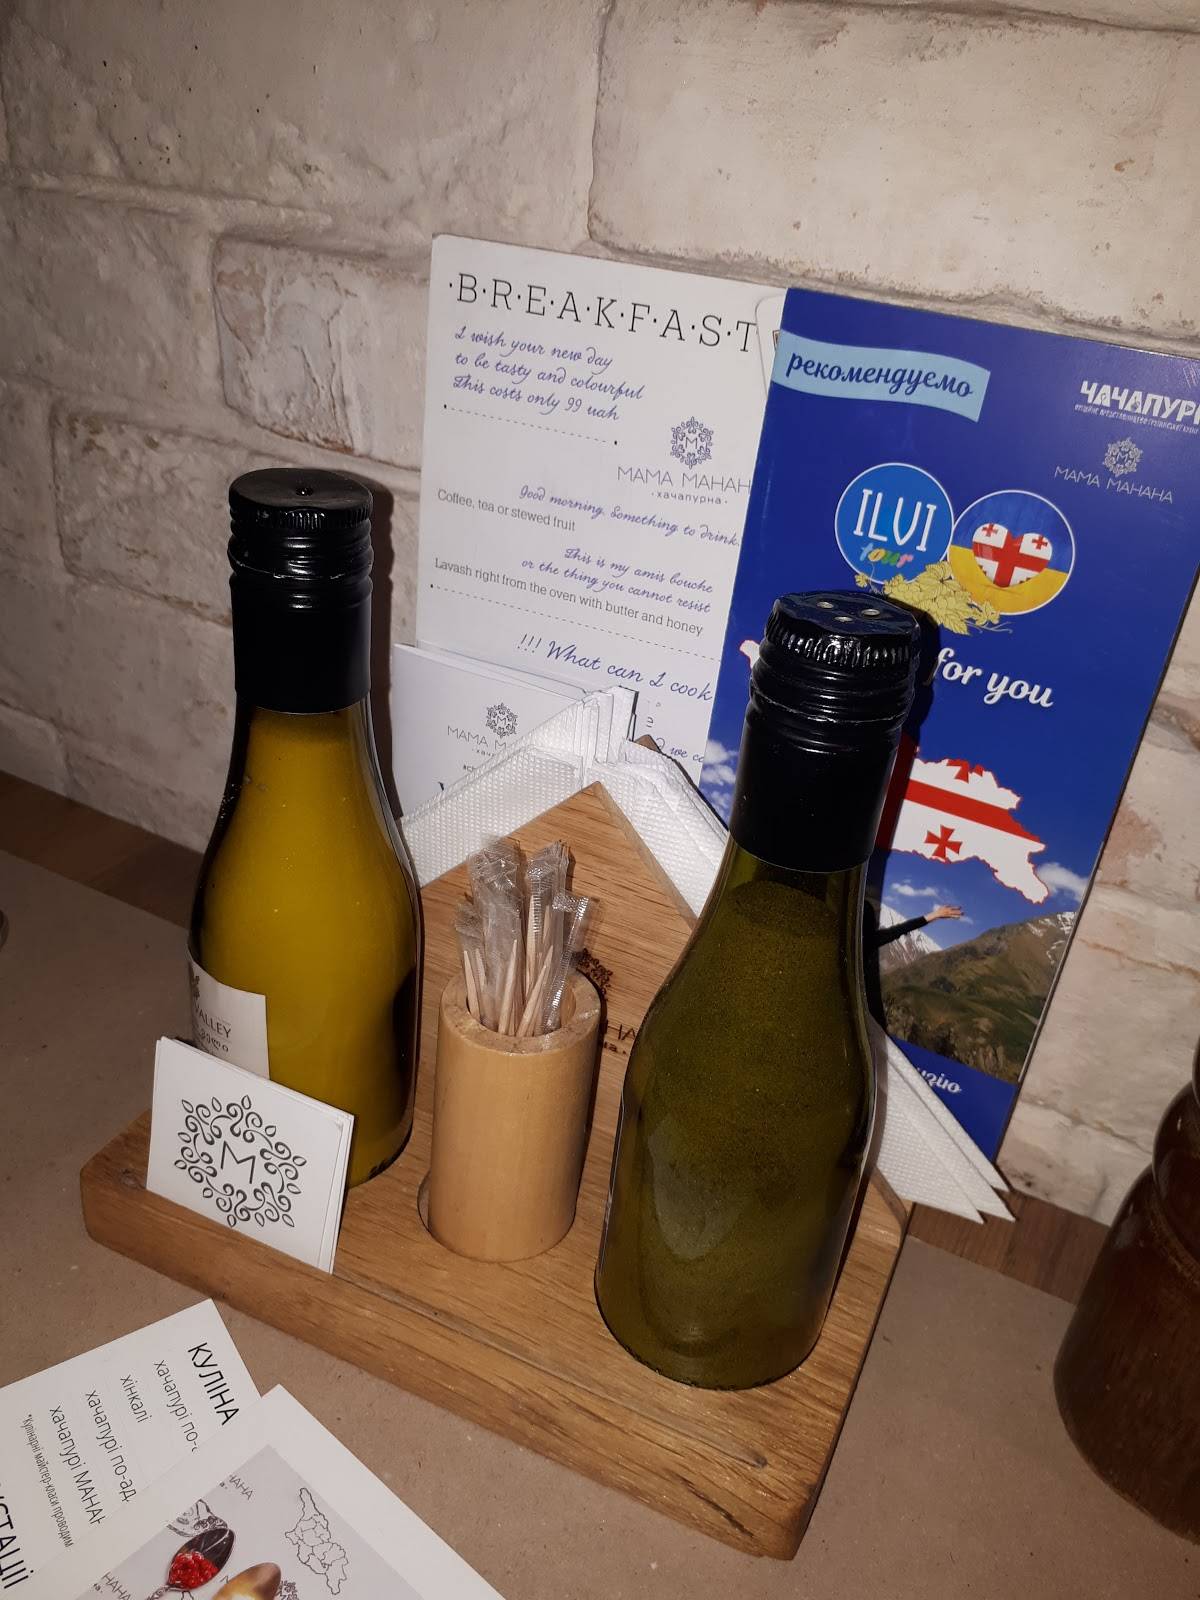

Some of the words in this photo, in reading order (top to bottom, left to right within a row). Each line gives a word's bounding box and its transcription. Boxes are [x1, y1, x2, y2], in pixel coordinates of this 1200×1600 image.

[455, 353, 468, 365] to
[474, 352, 490, 369] be
[495, 358, 532, 384] tasty
[537, 367, 566, 384] and
[570, 375, 646, 400] colourful
[471, 331, 505, 347] wish
[500, 340, 545, 358] your
[551, 346, 582, 361] new
[586, 346, 614, 375] day
[785, 353, 973, 397] рекомендуємо
[453, 374, 485, 394] This
[489, 381, 523, 401] costs
[527, 392, 560, 415] only
[565, 397, 582, 413] 99
[587, 405, 620, 421] uah
[617, 466, 673, 487] МАМА
[682, 472, 751, 495] МАНАН
[1054, 466, 1101, 488] МАМА
[1106, 478, 1173, 504] МАНАНА
[437, 488, 475, 509] Coffee,
[478, 499, 495, 513] tea
[497, 505, 509, 516] or
[511, 508, 551, 526] stewed
[553, 516, 576, 532] fruit
[610, 505, 678, 537] Something
[683, 524, 695, 537] to
[564, 548, 592, 565] This
[596, 557, 605, 568] is
[610, 561, 630, 578] my
[634, 568, 666, 582] amis
[670, 572, 713, 593] bouche
[860, 543, 914, 568] tour
[435, 557, 473, 577] Lavash
[475, 567, 501, 584] right
[502, 574, 527, 591] from
[530, 581, 547, 596] the
[549, 588, 576, 603] oven
[579, 595, 603, 610] with
[605, 600, 640, 619] butter
[641, 611, 663, 625] and
[666, 617, 704, 638] honey
[521, 560, 534, 569] or
[539, 561, 560, 575] the
[563, 567, 599, 590] thing
[594, 580, 625, 593] you
[628, 586, 673, 604] cannot
[676, 597, 712, 613] resist
[546, 640, 601, 671] What
[607, 664, 644, 682] can
[669, 682, 713, 702] cook
[933, 647, 982, 685] for
[984, 673, 1054, 708] you
[447, 725, 489, 747] МАМА
[120, 1374, 153, 1423] хінкалі
[153, 1359, 193, 1421] хачапурі
[187, 1342, 240, 1426] КУЛІНА
[49, 1405, 86, 1471] хачапурі
[85, 1390, 123, 1454] хачапурі
[110, 1455, 137, 1503] по-ад
[51, 1506, 74, 1548] проводим
